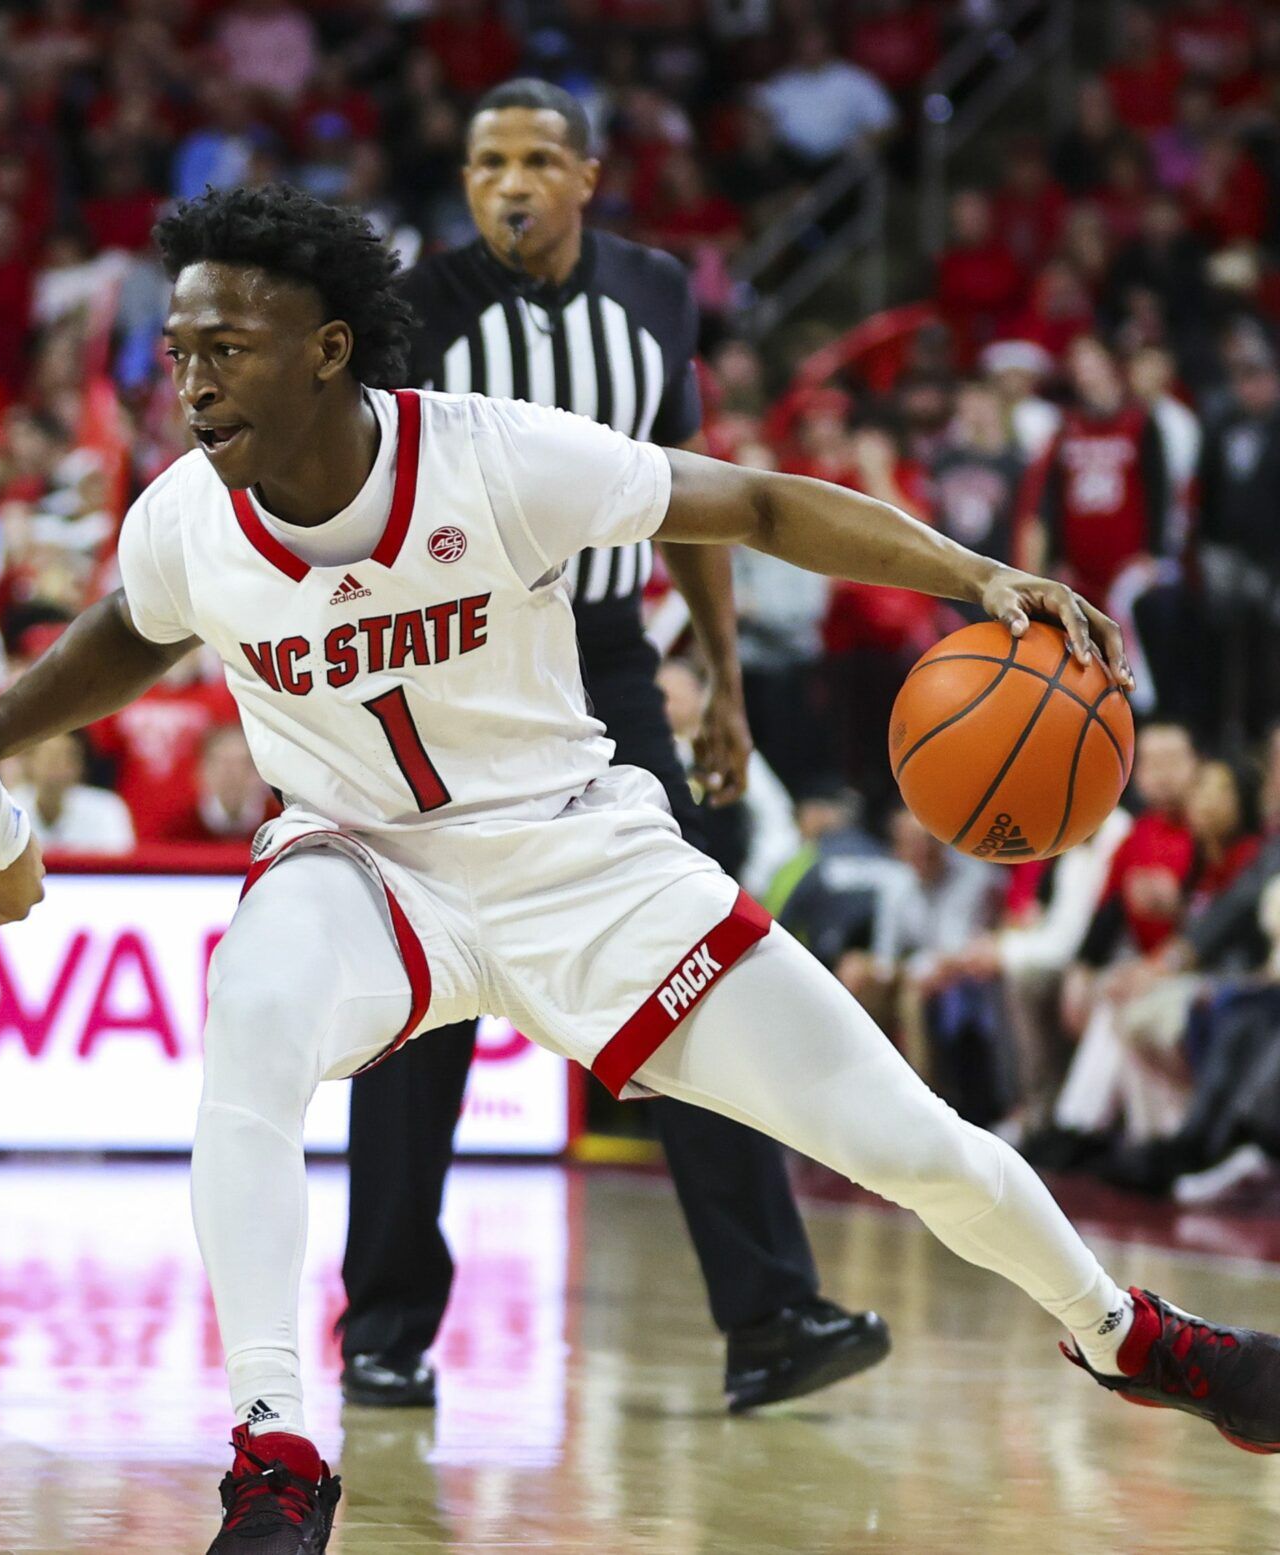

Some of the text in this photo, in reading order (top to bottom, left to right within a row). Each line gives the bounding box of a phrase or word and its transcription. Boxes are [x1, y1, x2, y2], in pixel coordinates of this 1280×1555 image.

[329, 588, 372, 606] adidas
[239, 592, 492, 696] NC STATE
[360, 684, 453, 814] 1
[971, 812, 1013, 858] adidas
[656, 941, 723, 1022] PACK
